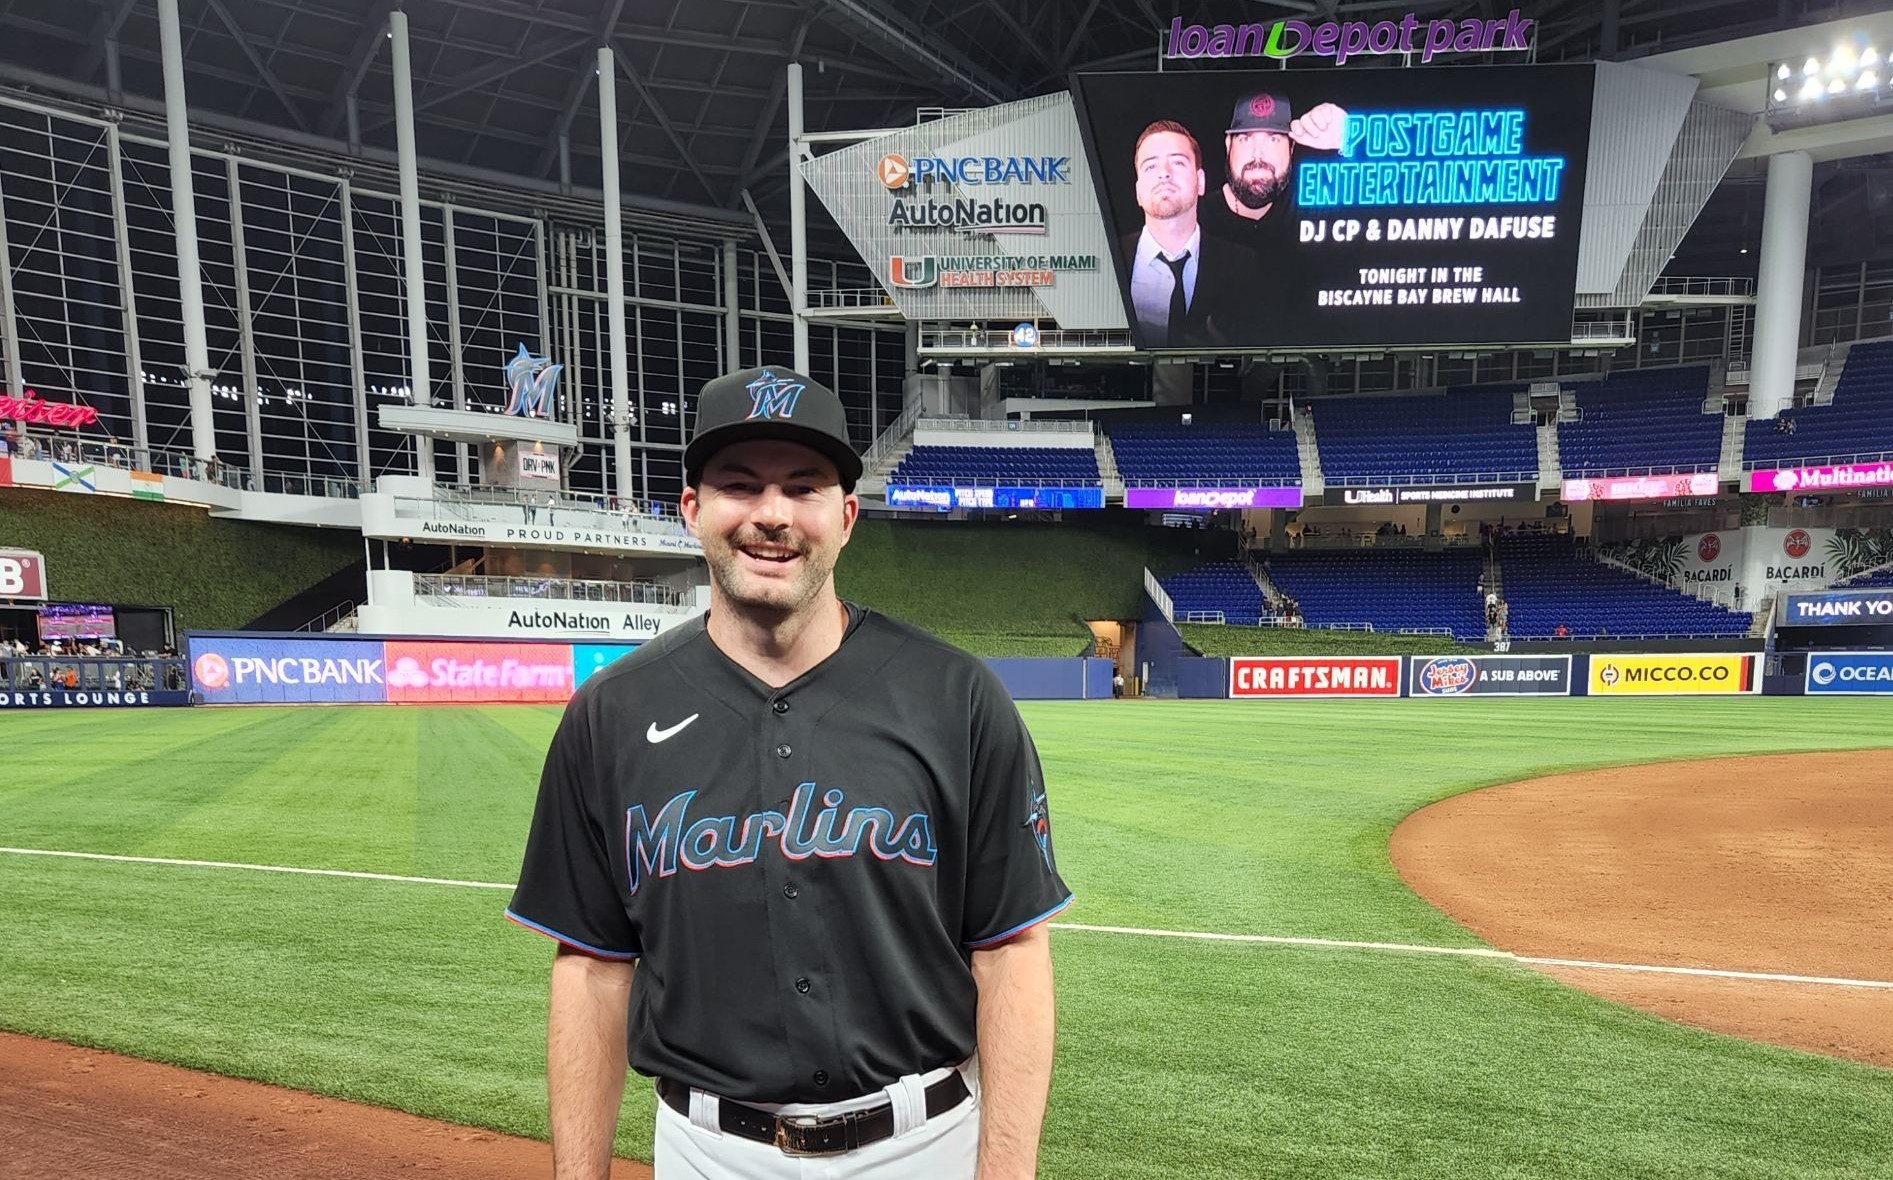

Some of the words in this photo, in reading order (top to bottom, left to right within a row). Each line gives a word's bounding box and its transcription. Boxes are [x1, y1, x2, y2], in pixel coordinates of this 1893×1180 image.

[1167, 13, 1419, 66] loanDepot
[1422, 8, 1534, 63] park
[1343, 110, 1525, 156] POSTGAME
[1299, 158, 1564, 206] ENTERTAINMENT
[888, 198, 1046, 227] AutoNation
[1300, 219, 1326, 242] DJ
[1331, 219, 1361, 242] CP
[1366, 218, 1382, 241] &
[1387, 217, 1464, 241] DANNY
[1469, 216, 1557, 240] DAFUSE
[941, 256, 1022, 270] UNIVERSITY
[1027, 256, 1047, 269] OF
[1050, 255, 1096, 269] MIAMI
[940, 271, 993, 286] HEALTH
[995, 270, 1053, 285] SYSTEM
[1359, 268, 1427, 285] TONIGHT
[1431, 267, 1448, 283] IN
[1453, 266, 1483, 283] THE
[1318, 289, 1393, 306] BISCAYNE
[1397, 288, 1428, 305] BAY
[1432, 288, 1477, 304] BREW
[1482, 287, 1521, 303] HALL
[1014, 327, 1035, 343] 42
[1400, 490, 1430, 501] SPORTS
[423, 522, 485, 536] AutoNation
[507, 529, 565, 542] PROUD
[574, 532, 648, 547] PARTNERS
[1766, 562, 1827, 580] BACARDÍ
[1796, 601, 1861, 617] THANK
[508, 610, 610, 630] AutoNation
[622, 612, 661, 633] Alley
[1493, 641, 1511, 652] 387
[1480, 671, 1489, 681] A
[1491, 670, 1514, 681] SUB
[1517, 669, 1559, 681] ABOVE
[1625, 666, 1729, 682] MICCO.CO
[1839, 666, 1893, 681] OCEA
[64, 692, 149, 705] LOUNGE
[625, 781, 938, 896] Marlins
